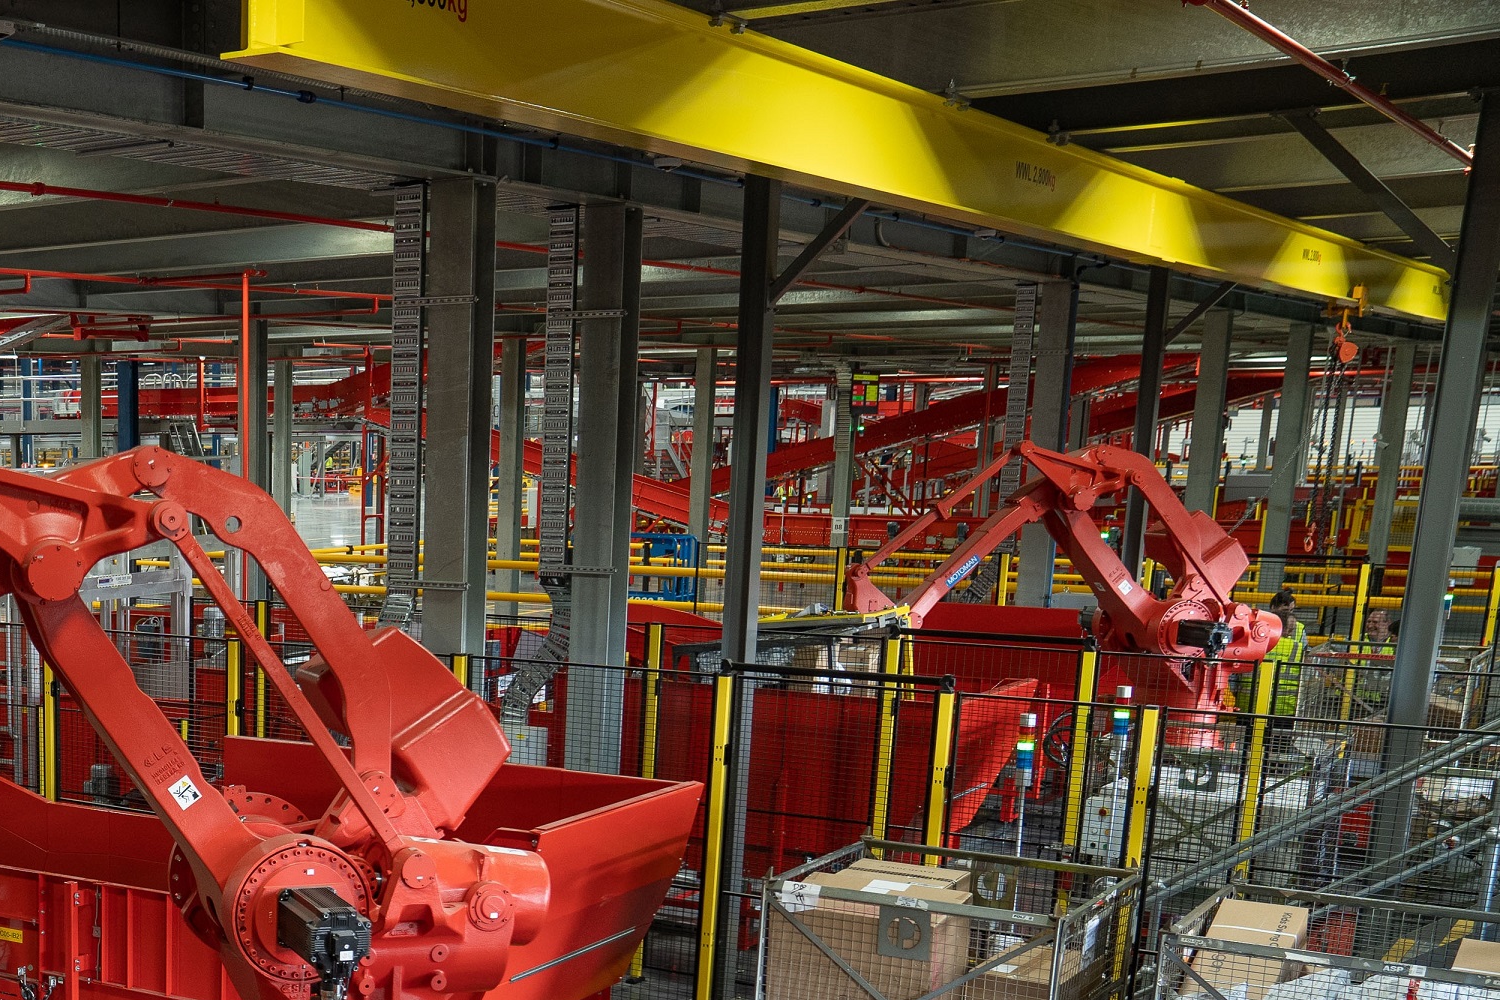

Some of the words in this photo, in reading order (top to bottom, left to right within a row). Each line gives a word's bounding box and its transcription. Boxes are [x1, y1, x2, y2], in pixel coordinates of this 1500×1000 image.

[946, 555, 978, 586] MOTOMAN
[1278, 912, 1293, 926] Kids
[1268, 924, 1287, 941] Swng
[1382, 964, 1404, 973] ASP
